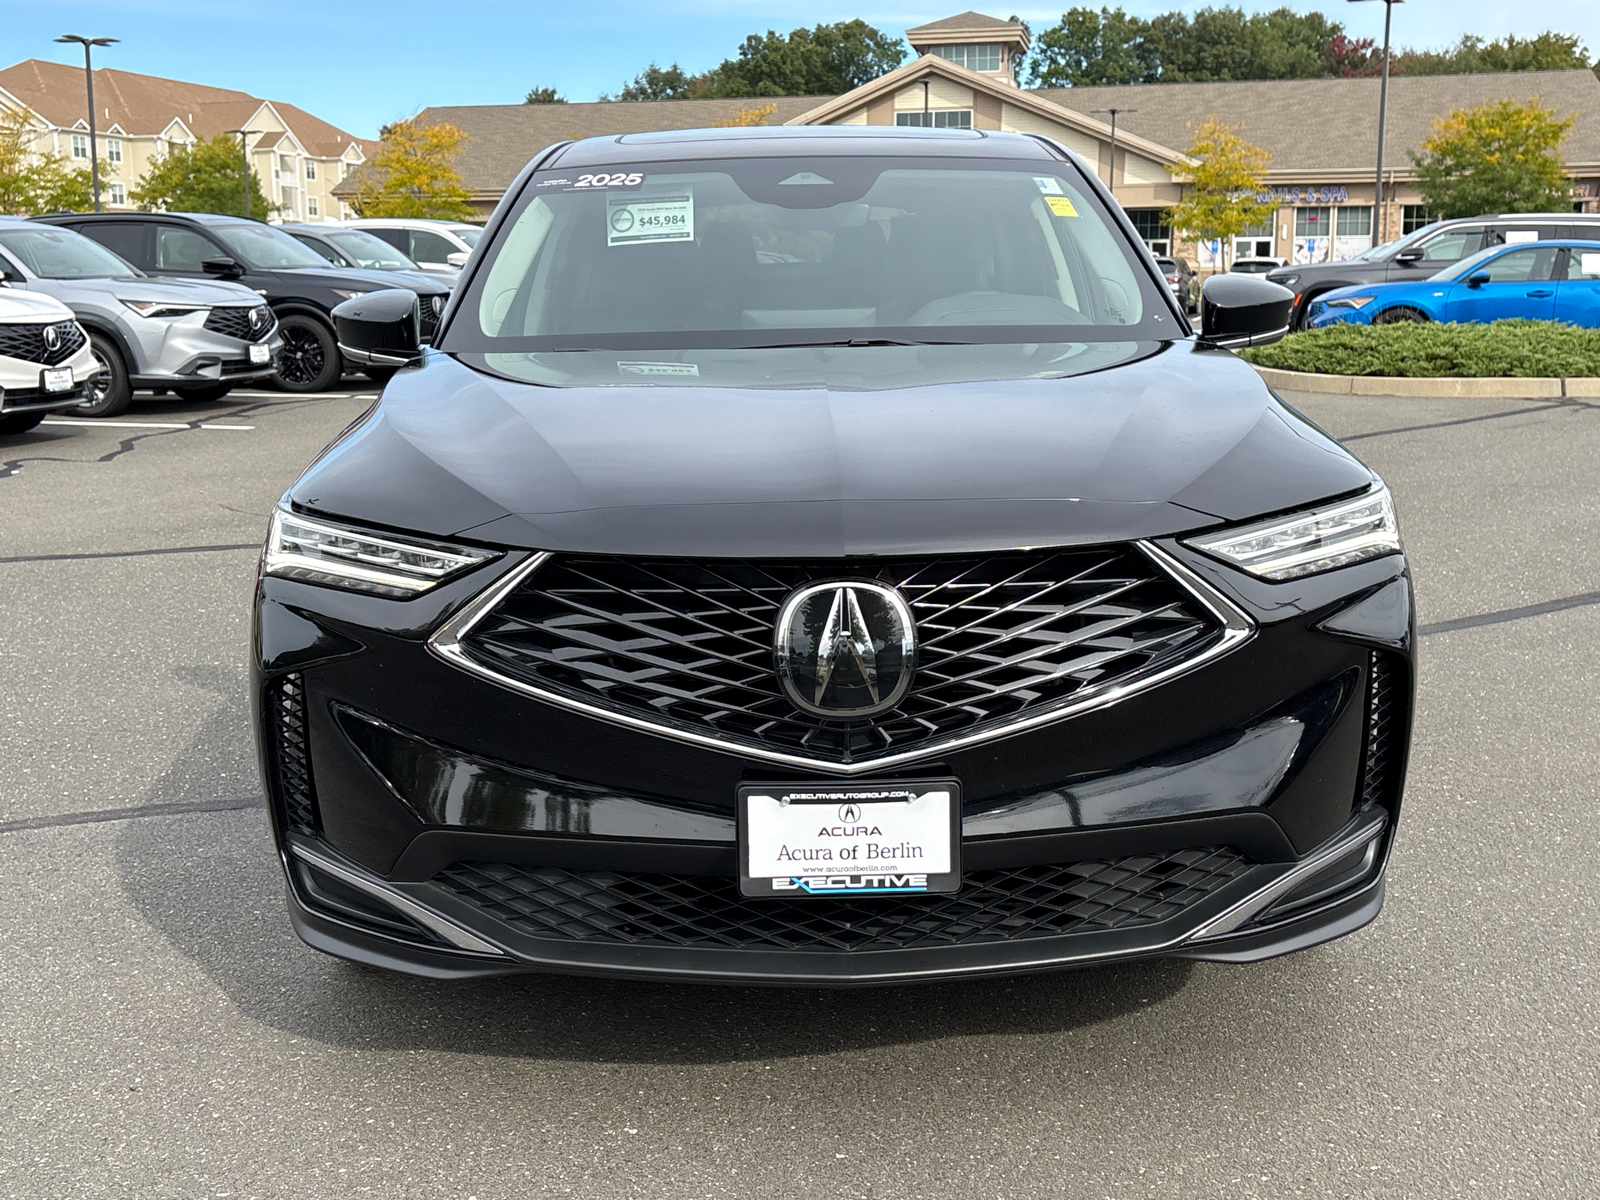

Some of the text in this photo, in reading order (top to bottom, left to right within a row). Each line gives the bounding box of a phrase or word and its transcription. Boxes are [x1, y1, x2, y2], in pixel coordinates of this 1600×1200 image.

[574, 173, 644, 187] 2025
[1306, 187, 1317, 203] &
[1320, 186, 1348, 202] SPA
[639, 215, 686, 228] $45,984
[789, 791, 909, 800] EXECUTIVEAUTOGROUP.COM
[818, 826, 882, 837] ACURA
[776, 842, 924, 861] Acura of Berlin
[802, 864, 898, 873] www.acuraofberlin.com
[771, 874, 928, 893] EXECUTIVE
